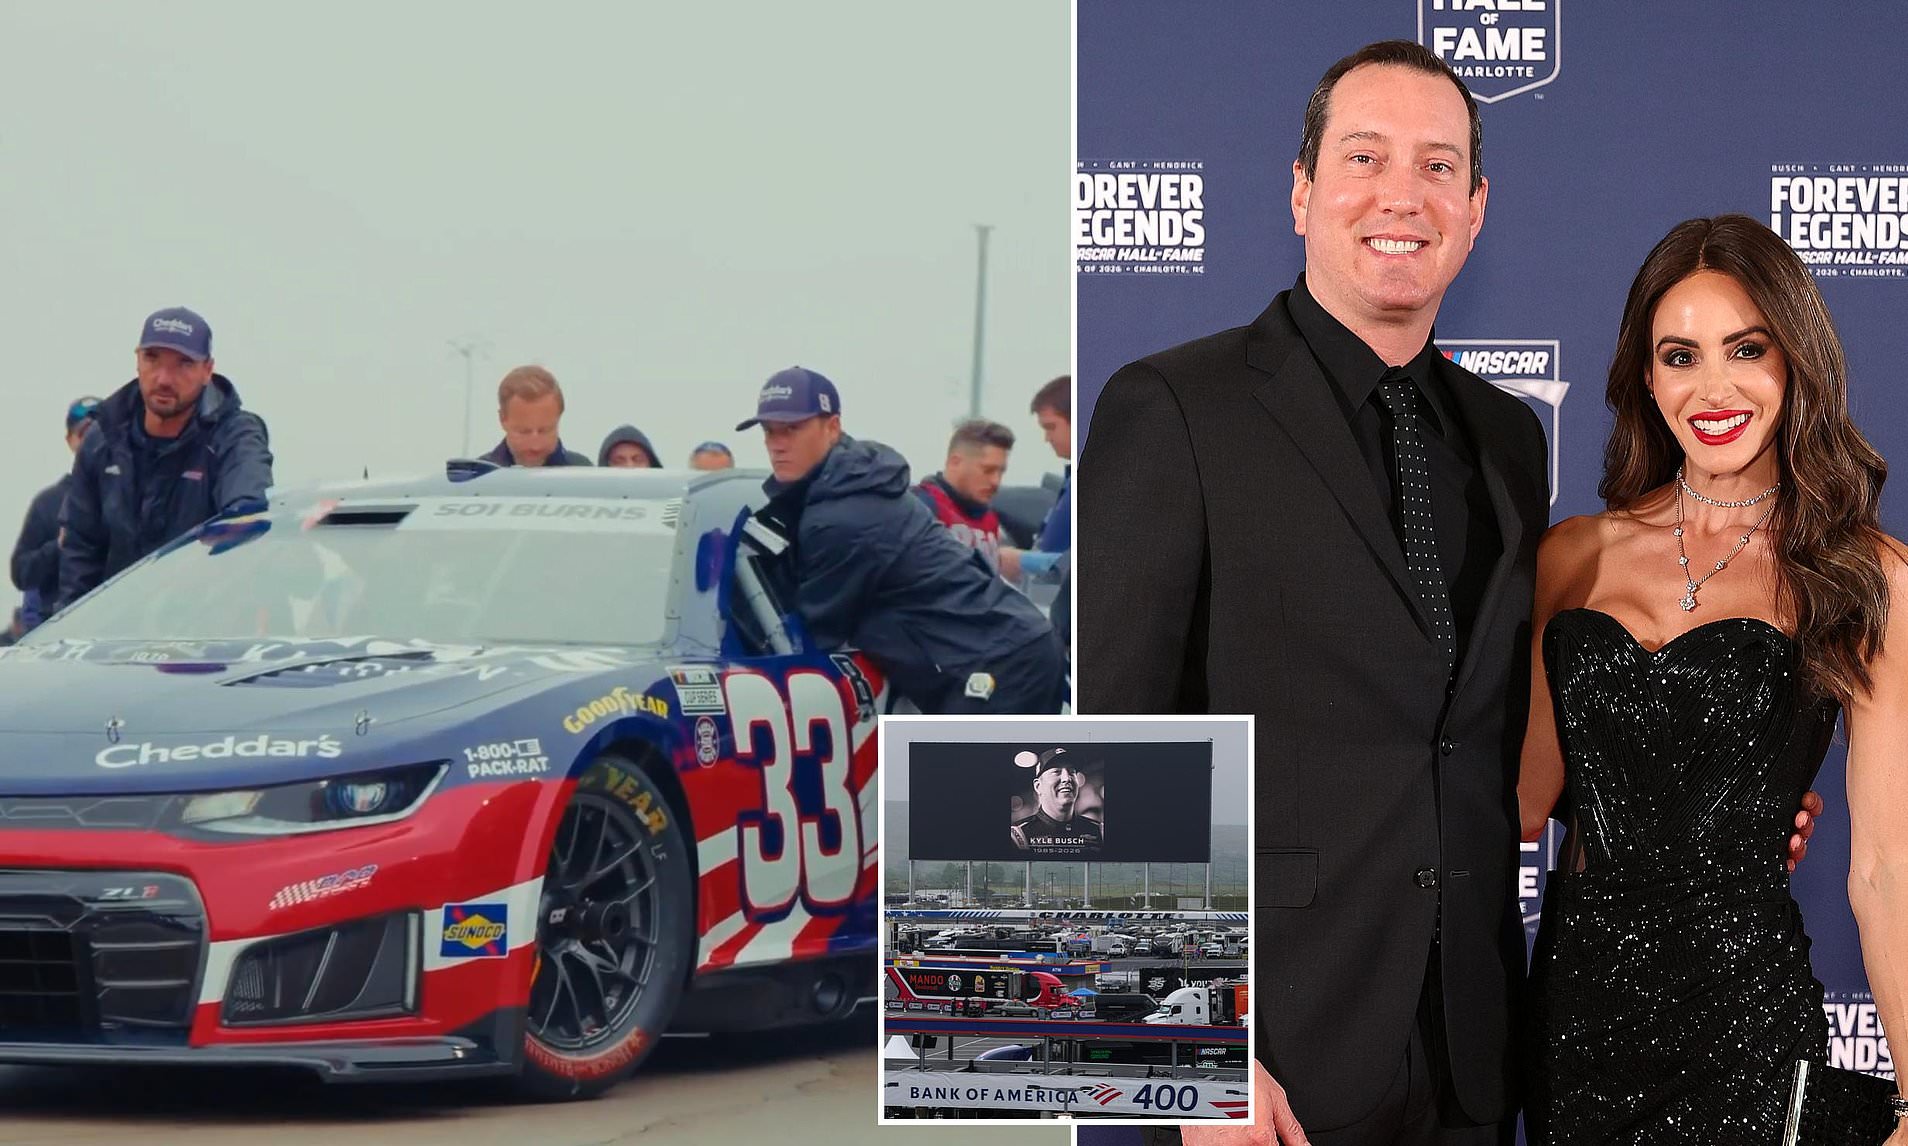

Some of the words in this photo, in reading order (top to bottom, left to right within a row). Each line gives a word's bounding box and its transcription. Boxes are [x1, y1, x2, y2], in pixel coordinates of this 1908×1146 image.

[1480, 13, 1498, 24] OF
[1433, 28, 1545, 60] FAME
[1453, 66, 1534, 77] HARLOTTE
[1109, 161, 1136, 169] GANT
[1153, 161, 1203, 169] HENDRICK
[1771, 164, 1804, 172] BUSCH
[1829, 164, 1856, 172] GANT
[1077, 173, 1204, 209] OREVER
[1077, 210, 1205, 246] EGENDS
[1077, 248, 1116, 260] ASCAR
[1117, 248, 1158, 260] HALL
[1161, 248, 1205, 260] FAME
[1797, 251, 1834, 264] SCAR
[1834, 251, 1874, 264] HALL
[1877, 251, 1908, 264] FAM
[1815, 268, 1838, 276] 2026
[1459, 351, 1549, 374] NASCAR
[508, 502, 648, 521] BURNS
[563, 686, 669, 734] GOODYEAR
[95, 734, 342, 768] Cheddar's
[468, 756, 549, 779] PACK-RAT
[725, 671, 860, 910] 33
[1039, 911, 1176, 919] CHARLOTTE
[447, 925, 503, 939] SUNOCO
[909, 974, 944, 985] MANDO
[1201, 1047, 1226, 1055] NASCAR
[910, 1087, 960, 1100] BANK
[966, 1088, 989, 1101] OF
[994, 1089, 1078, 1103] AMERICA
[1132, 1084, 1199, 1112] 400
